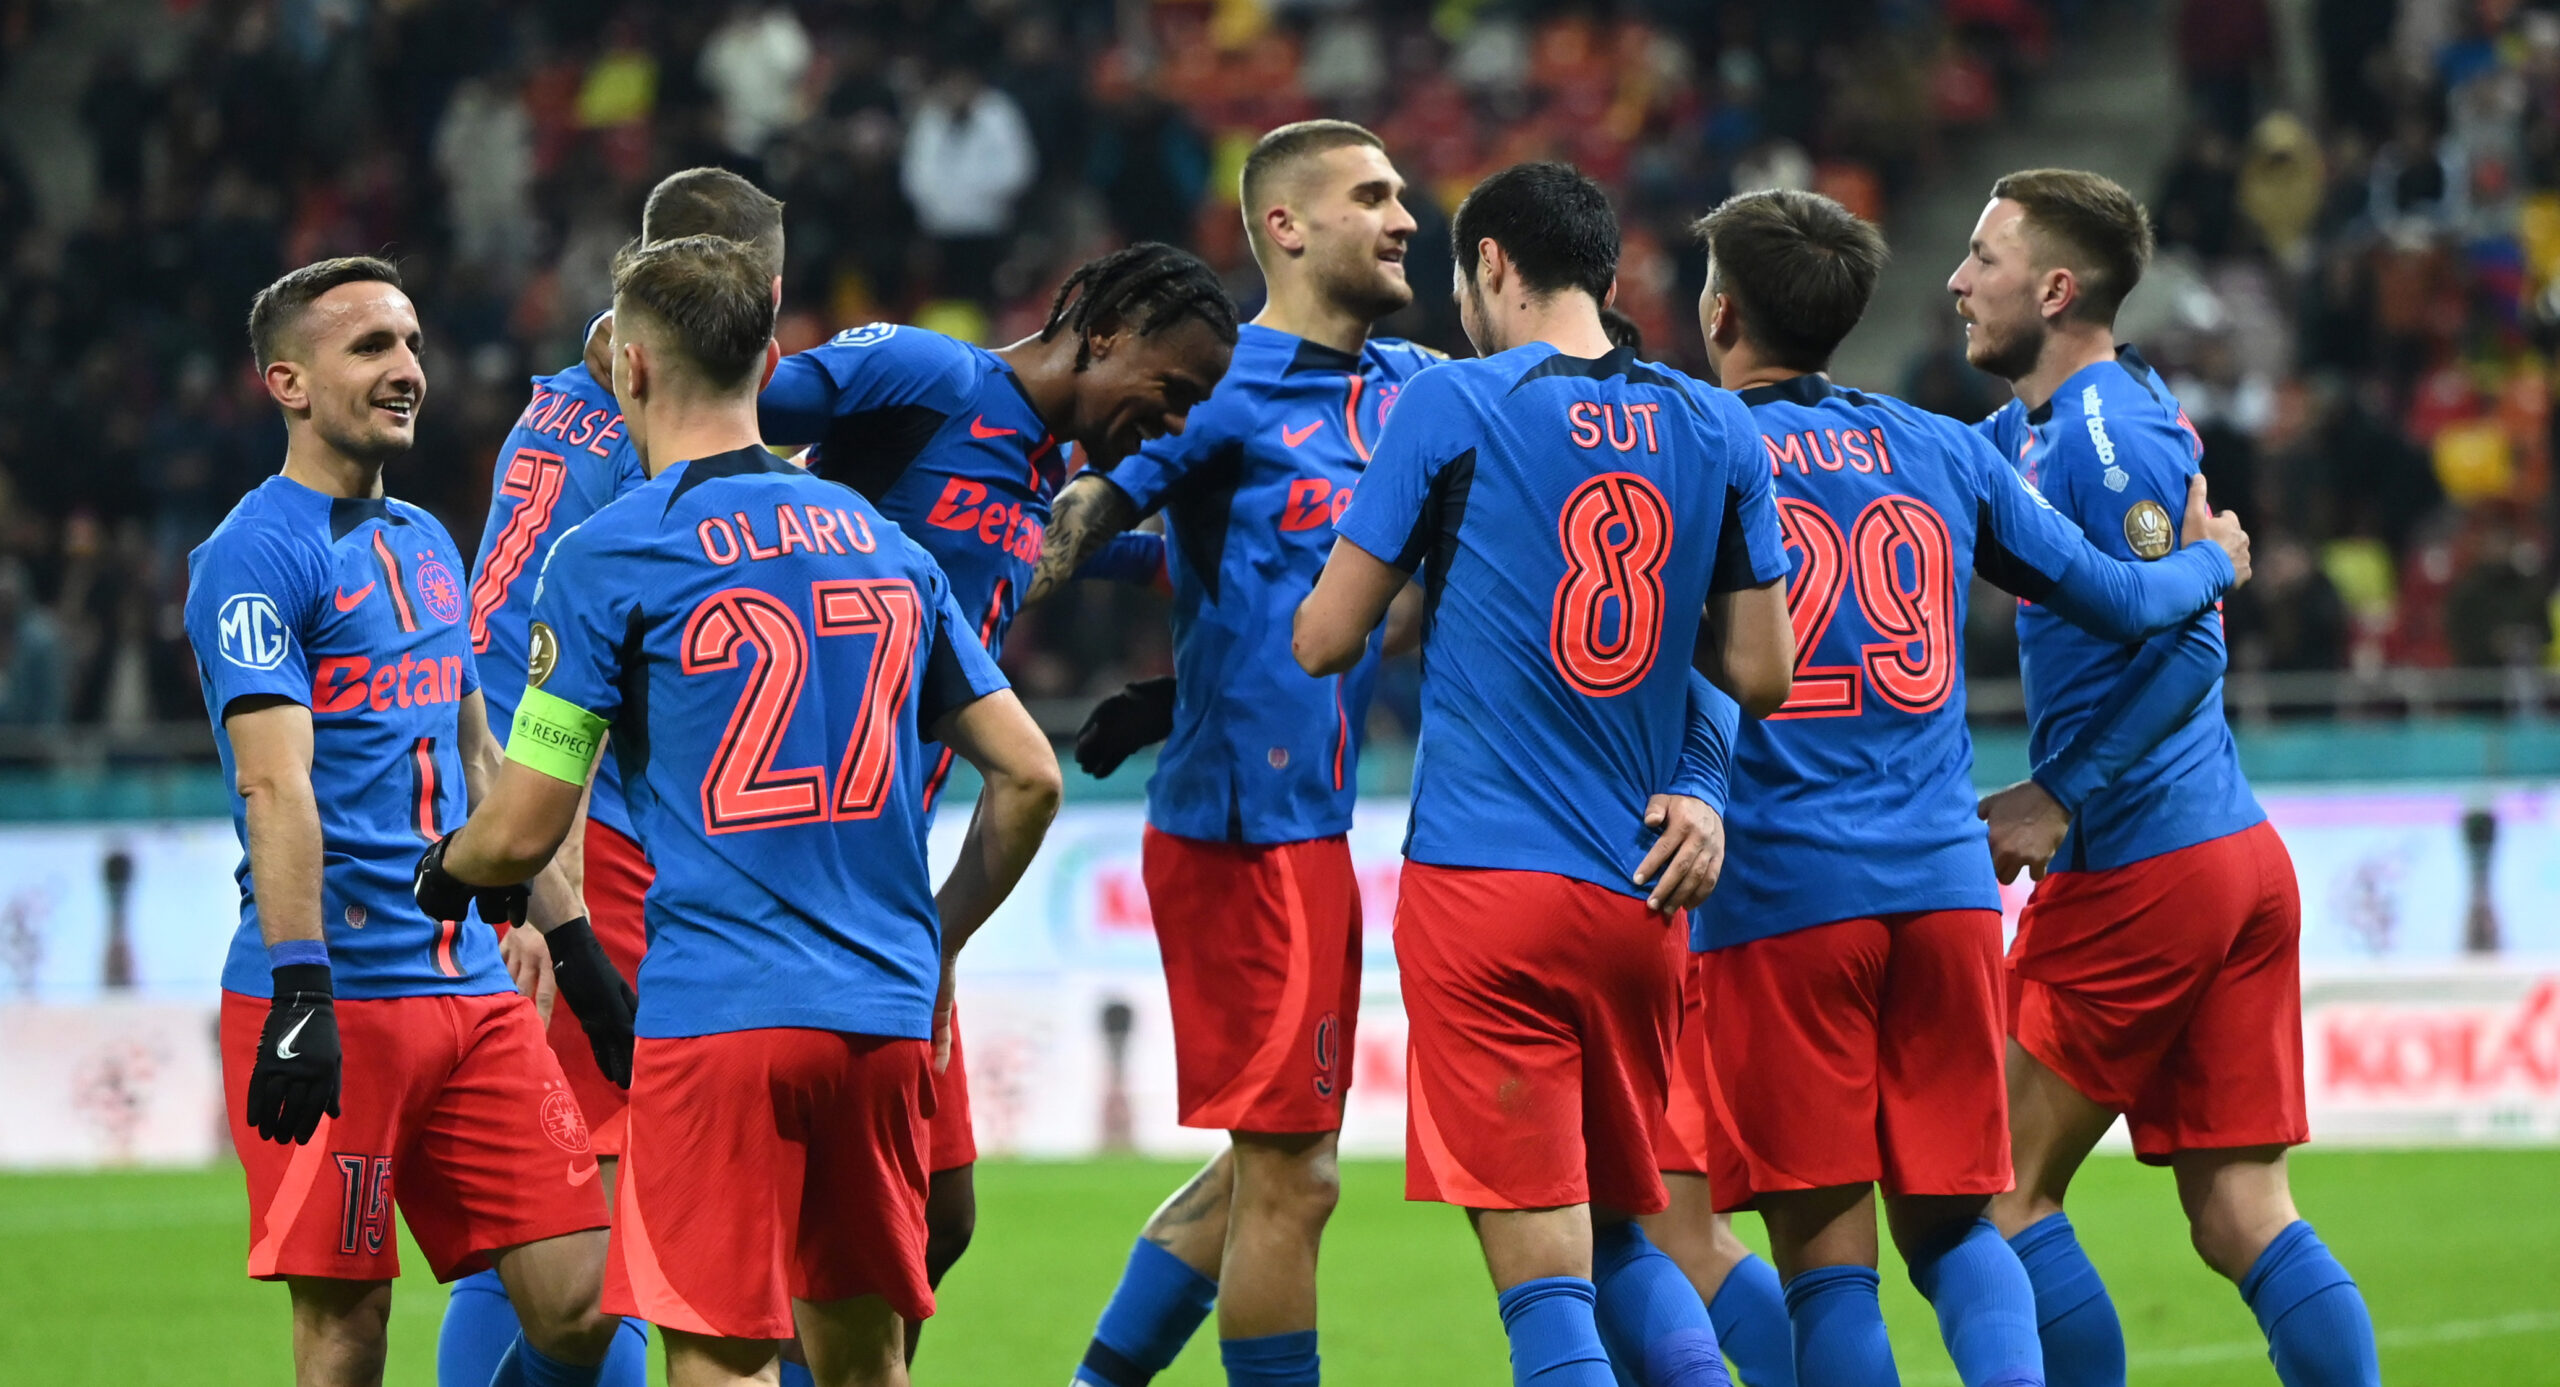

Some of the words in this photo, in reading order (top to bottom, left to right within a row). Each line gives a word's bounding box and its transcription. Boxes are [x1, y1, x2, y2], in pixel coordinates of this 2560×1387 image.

[1569, 401, 1660, 453] SUT
[1761, 427, 1892, 476] MUSI
[469, 447, 567, 654] 7
[697, 504, 877, 566] OLARU
[1550, 471, 1673, 697] 8
[1765, 494, 1956, 720] 29
[219, 600, 285, 664] MG
[532, 722, 593, 756] RESPECT
[681, 577, 922, 836] 27
[1312, 1010, 1340, 1101] 9
[332, 1151, 393, 1256] 15
